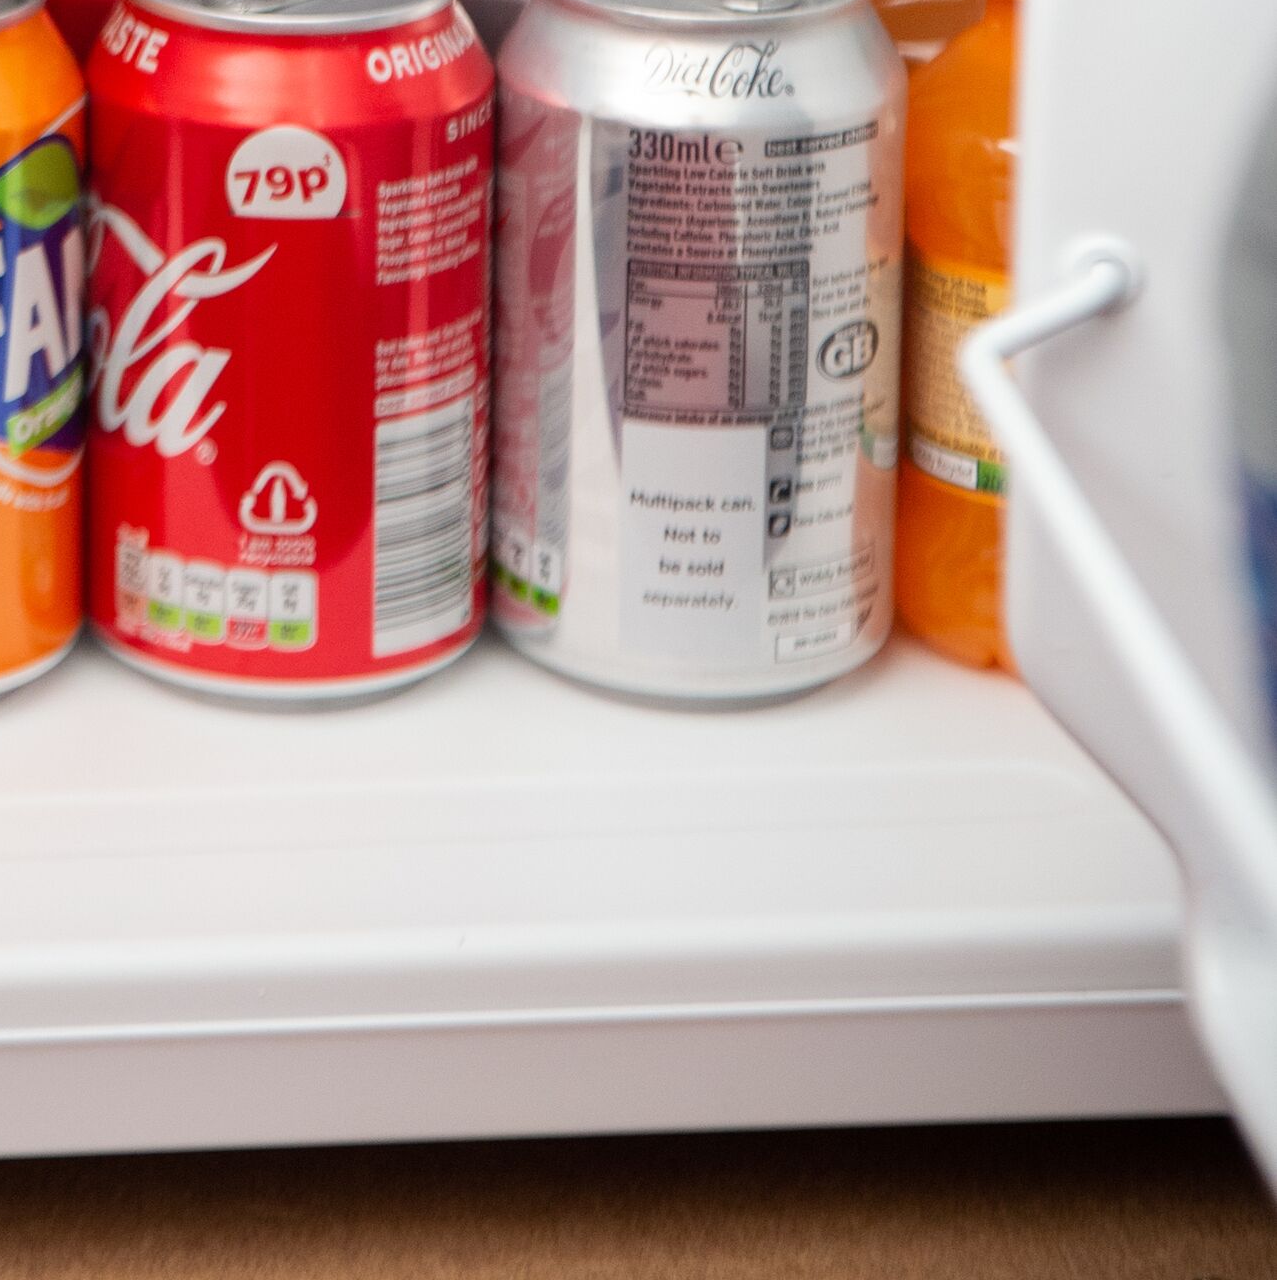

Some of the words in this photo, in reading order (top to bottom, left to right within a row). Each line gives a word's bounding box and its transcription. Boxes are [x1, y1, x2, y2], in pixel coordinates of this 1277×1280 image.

[644, 41, 711, 88] Diet
[709, 37, 786, 100] Coke
[628, 128, 710, 164] 330ml
[233, 162, 329, 208] 79p
[684, 166, 706, 181] Low
[630, 488, 715, 514] Multipack
[663, 525, 696, 544] Not
[702, 527, 721, 545] to
[658, 555, 682, 575] be
[687, 558, 725, 577] sold
